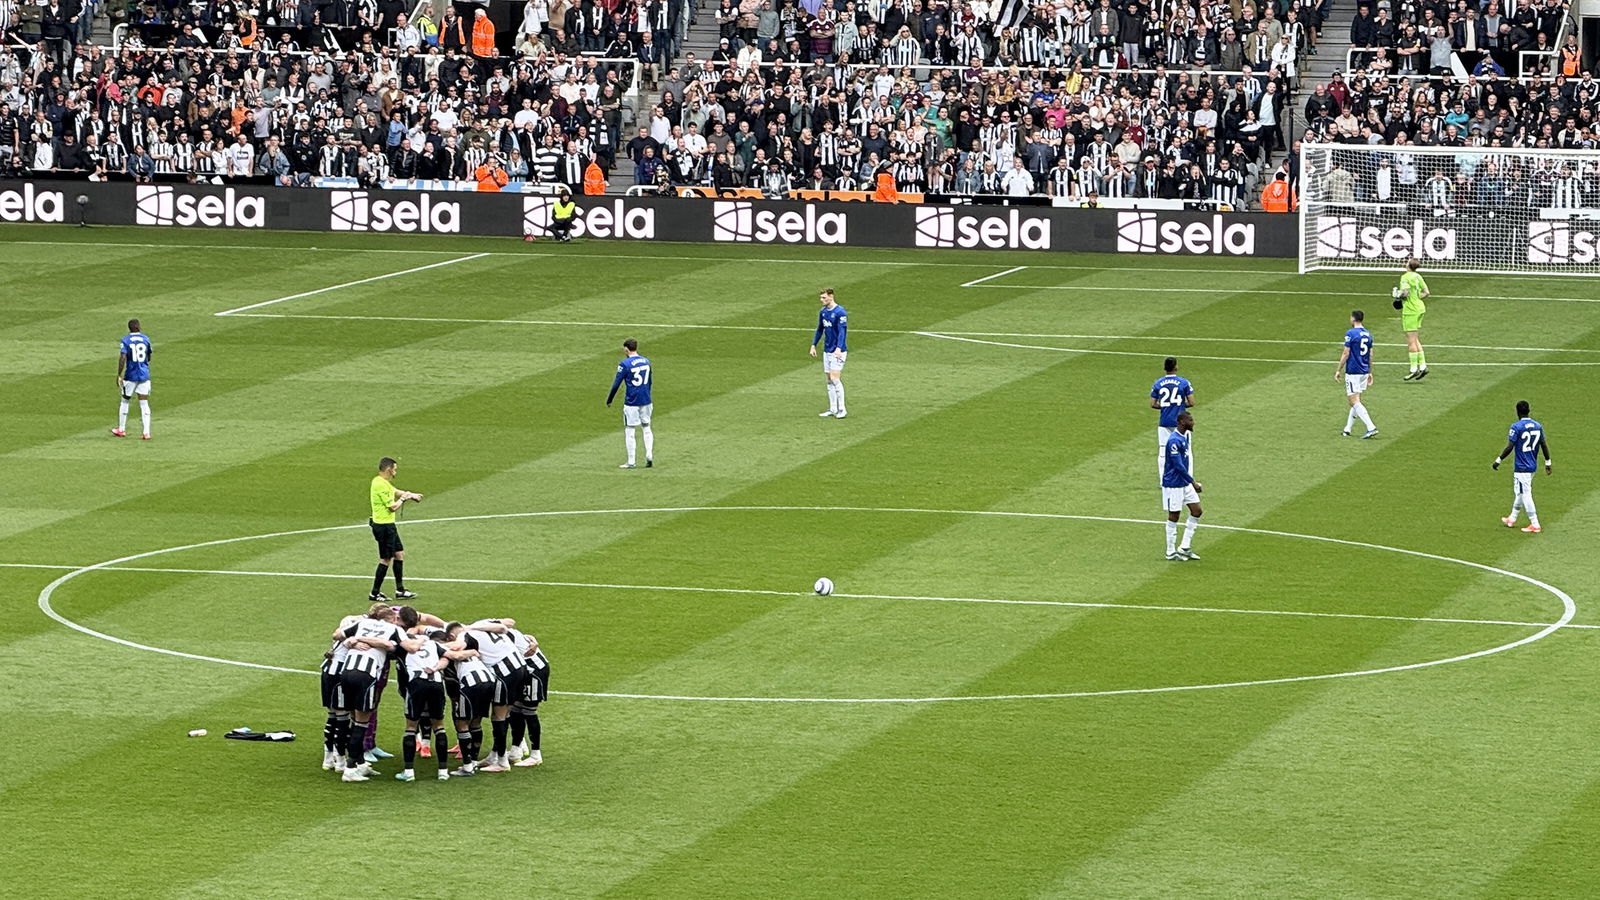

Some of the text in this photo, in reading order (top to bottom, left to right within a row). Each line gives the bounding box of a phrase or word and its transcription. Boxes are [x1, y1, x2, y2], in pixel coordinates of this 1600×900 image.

[176, 188, 264, 227] sela
[371, 193, 460, 232] sela
[567, 199, 654, 239] sela
[754, 204, 846, 243] sela
[956, 209, 1050, 249] sela
[1160, 215, 1254, 254] sela
[1360, 219, 1455, 259] sela
[129, 343, 147, 362] 18
[1359, 337, 1369, 356] 5
[630, 364, 651, 388] 37
[1158, 387, 1183, 407] 24
[1521, 430, 1541, 453] 27
